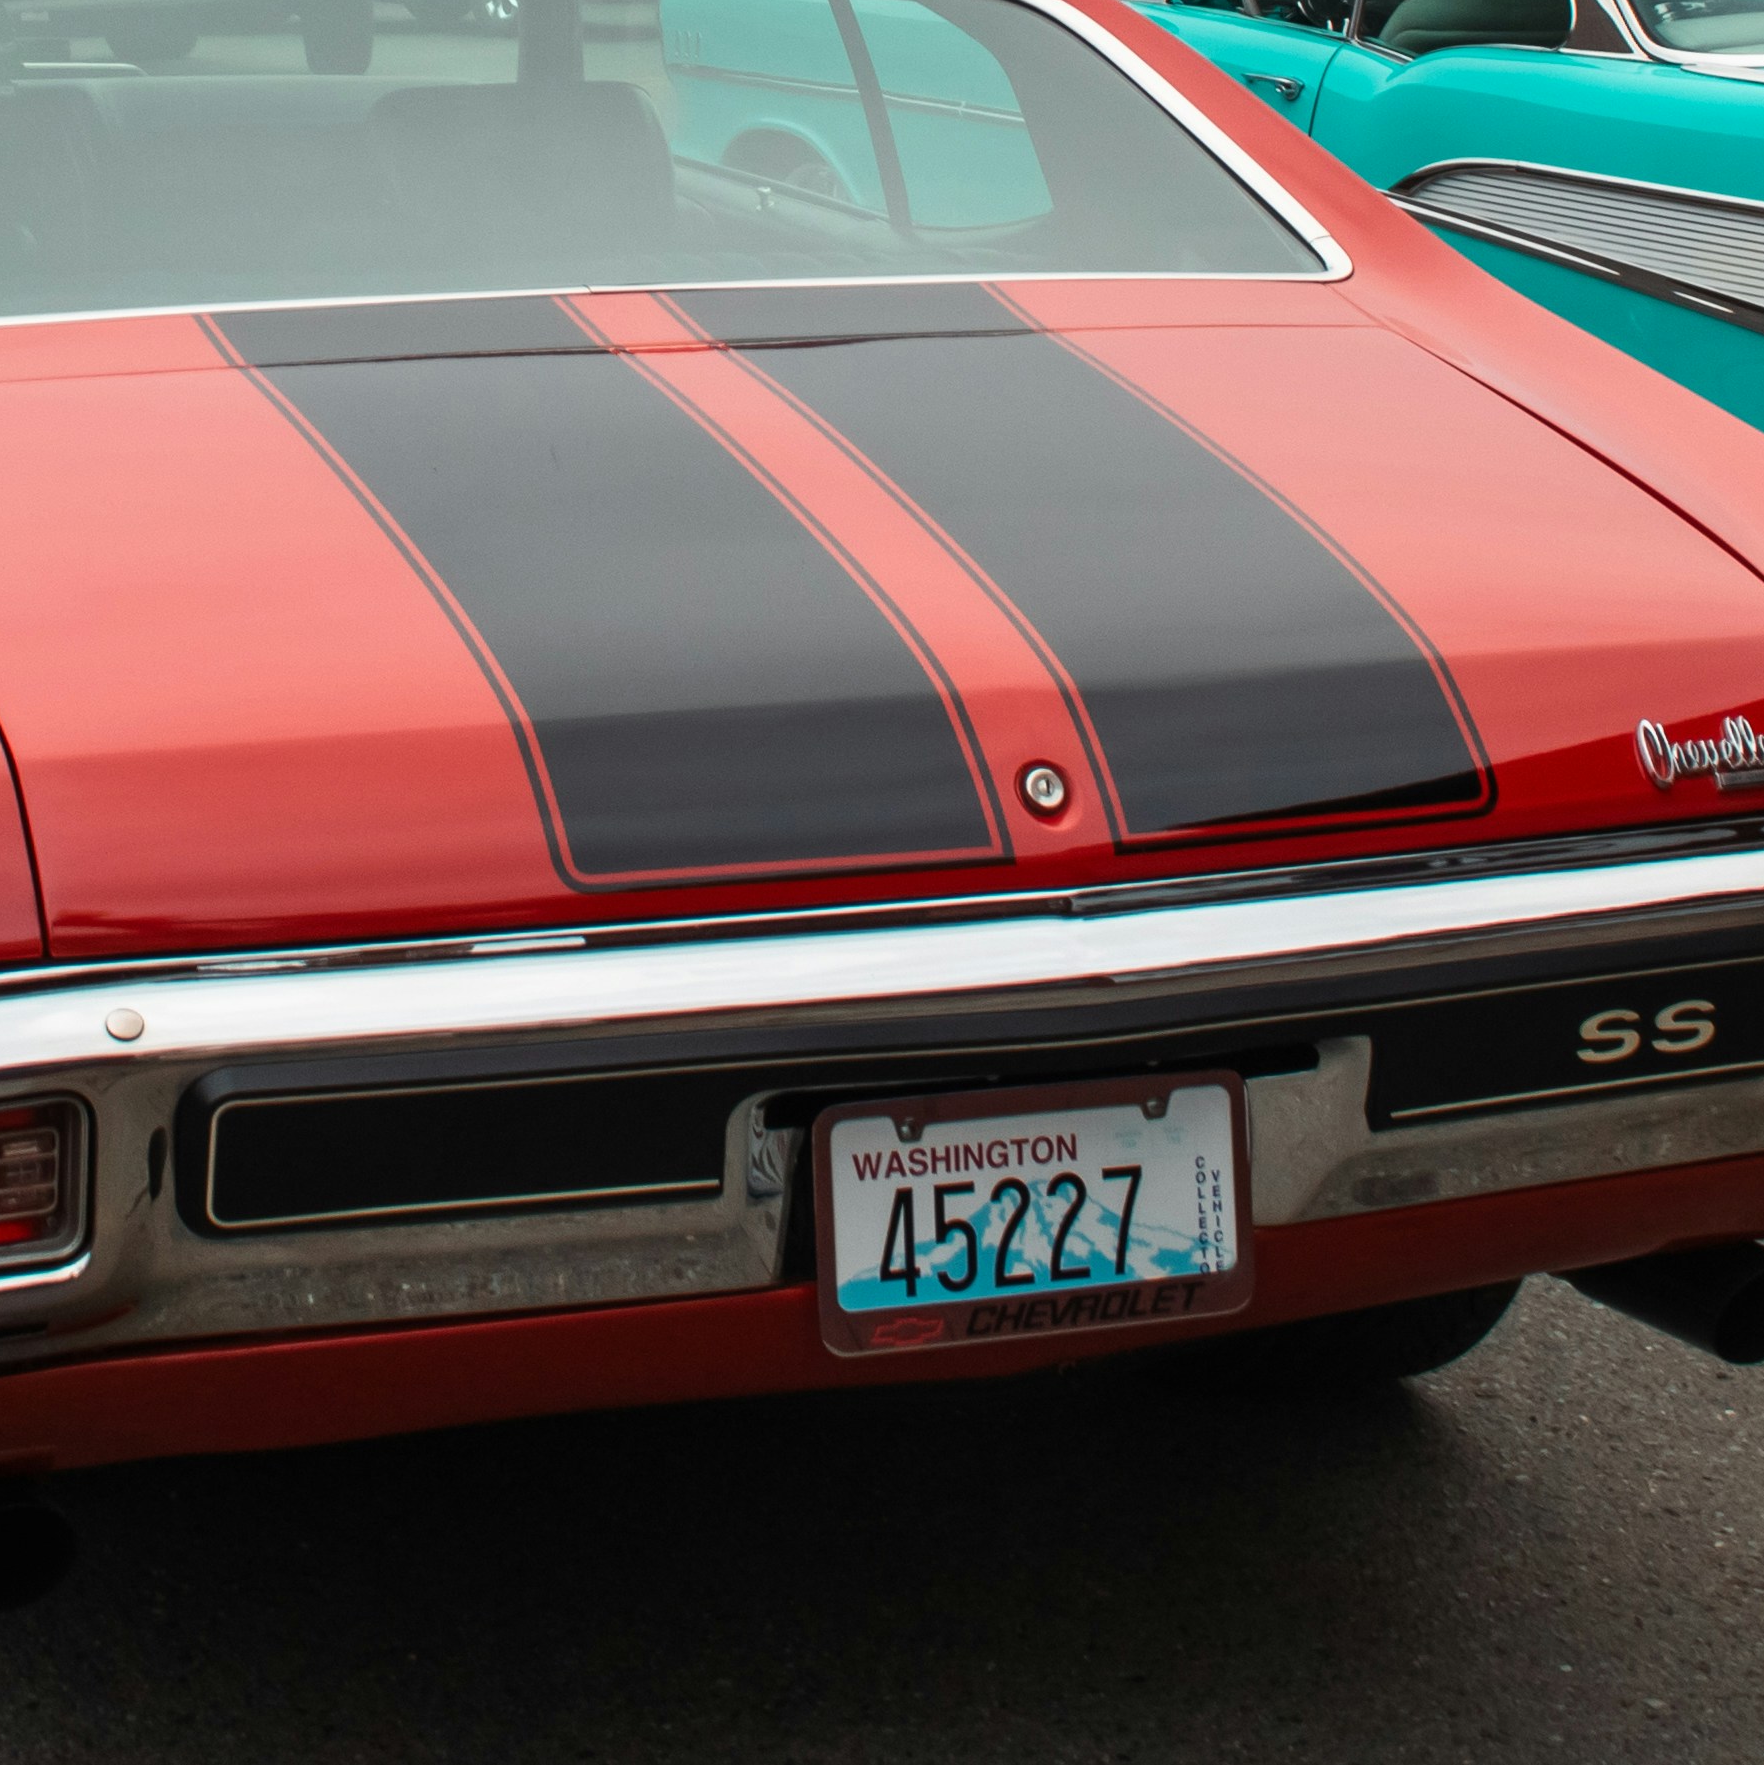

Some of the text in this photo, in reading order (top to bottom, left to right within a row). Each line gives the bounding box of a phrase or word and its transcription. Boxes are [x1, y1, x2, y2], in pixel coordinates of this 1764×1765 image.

[1576, 1000, 1716, 1064] SS
[852, 1133, 1078, 1181] WASHINGTON
[879, 1164, 1143, 1298] 45227
[1210, 1169, 1226, 1274] VEHICLE
[966, 1281, 1206, 1338] CHEVROLET
